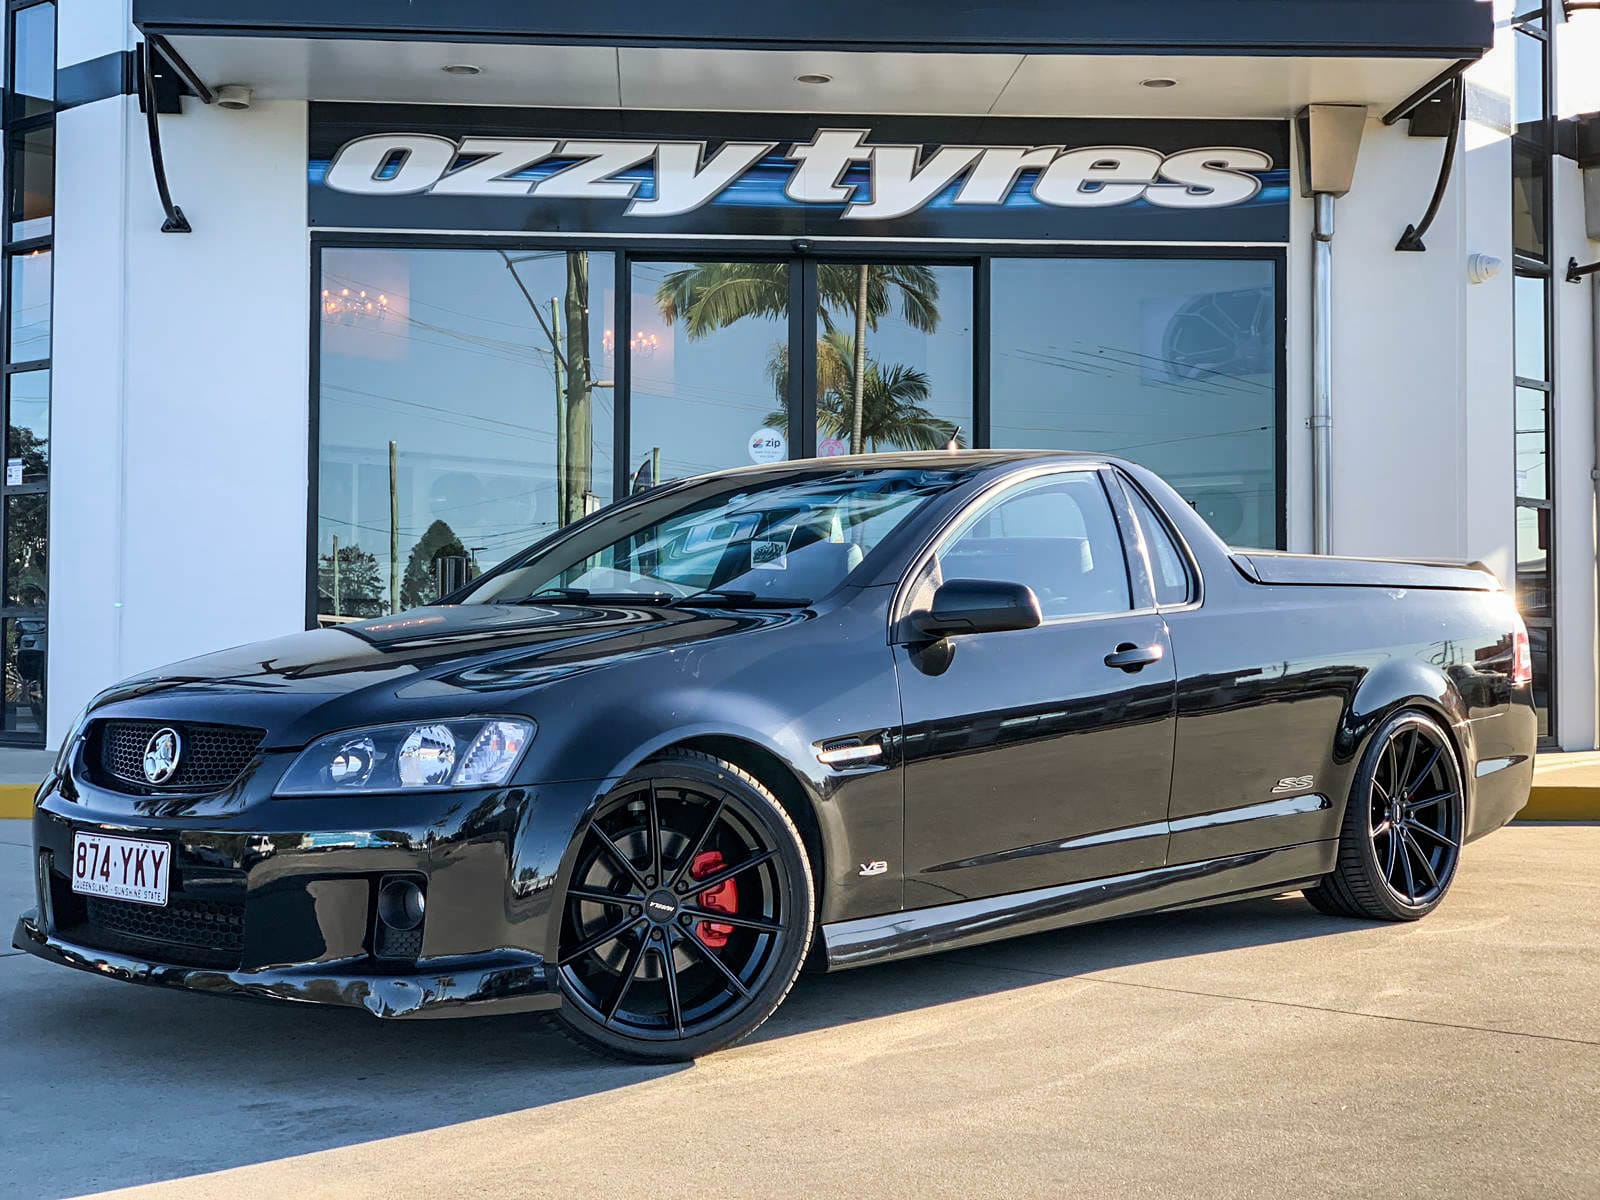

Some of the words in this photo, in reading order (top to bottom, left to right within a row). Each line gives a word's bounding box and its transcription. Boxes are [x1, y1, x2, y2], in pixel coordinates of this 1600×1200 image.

[323, 132, 780, 217] ozzy
[784, 127, 1275, 221] tyres
[765, 437, 781, 449] zip
[1272, 774, 1314, 793] SS
[859, 860, 888, 876] V8
[143, 890, 161, 901] STATE
